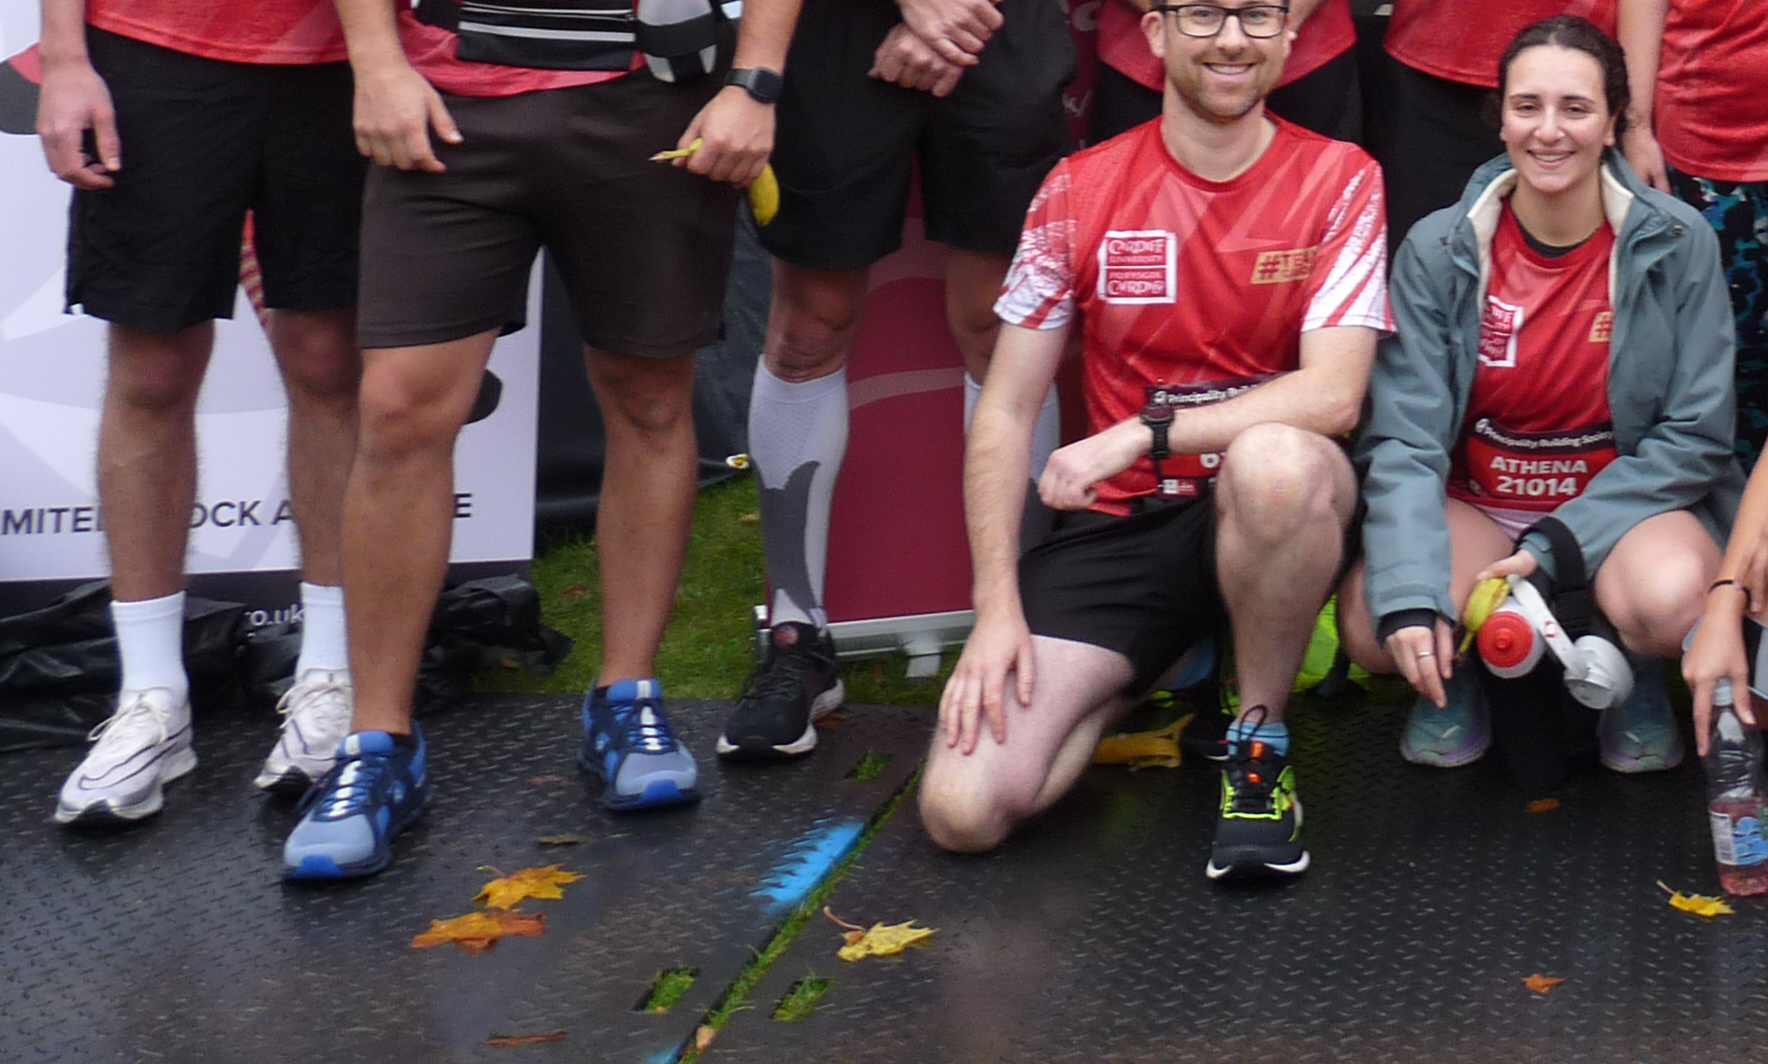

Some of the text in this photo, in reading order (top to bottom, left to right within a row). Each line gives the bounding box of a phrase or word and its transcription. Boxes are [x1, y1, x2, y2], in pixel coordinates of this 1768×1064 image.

[1108, 239, 1165, 256] CARDIFF
[1167, 389, 1227, 405] Principality
[1488, 455, 1588, 475] ATHENA
[1496, 475, 1577, 496] 21014
[2, 507, 100, 534] MITE
[190, 501, 260, 528] OCK
